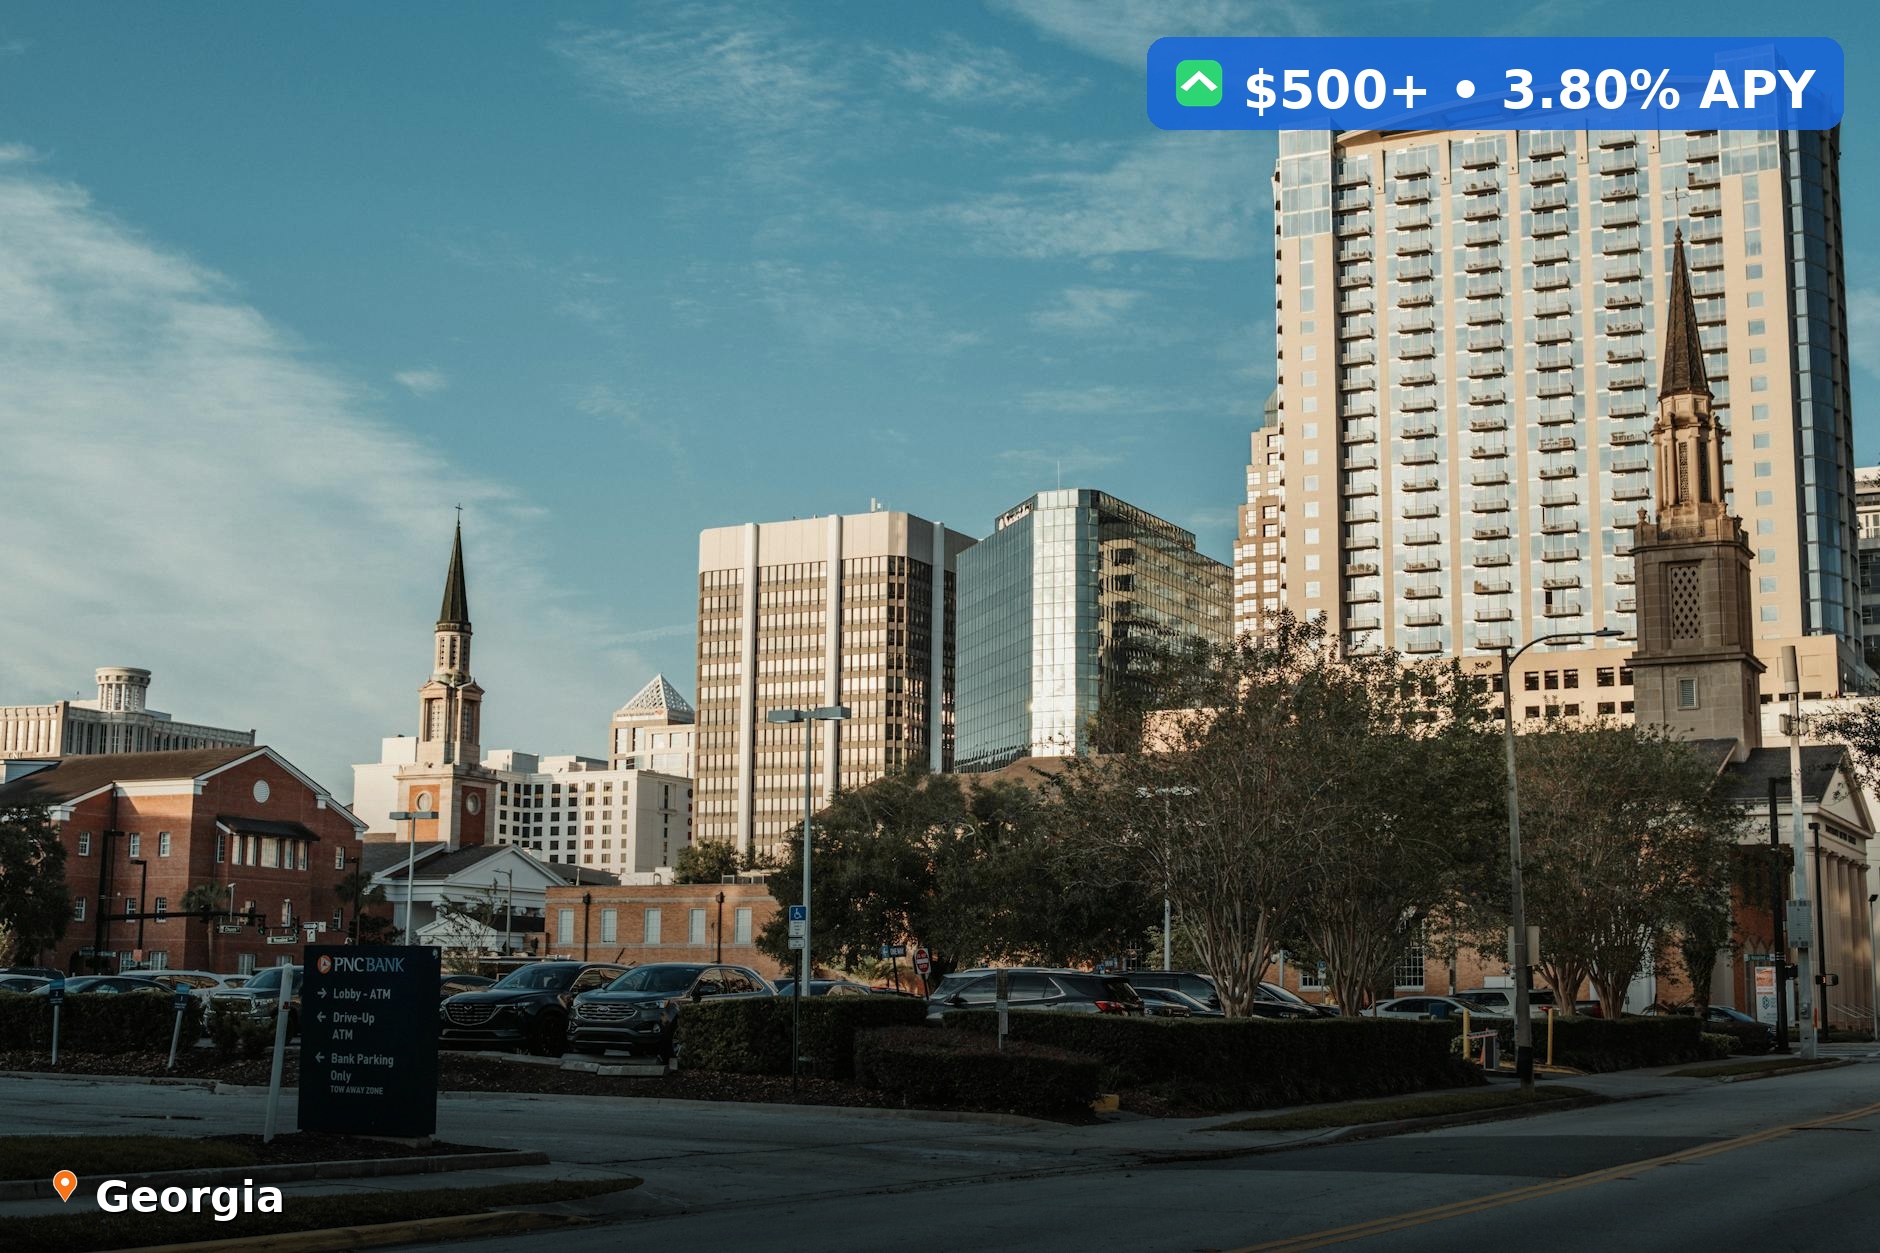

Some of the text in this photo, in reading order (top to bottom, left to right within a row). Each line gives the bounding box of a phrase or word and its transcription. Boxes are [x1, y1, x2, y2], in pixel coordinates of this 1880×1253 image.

[333, 988, 361, 1001] Lobby
[370, 988, 391, 1000] ATM
[333, 1012, 375, 1026] Drive-Up
[332, 1029, 353, 1040] ATM
[331, 1053, 394, 1068] Bank Parking
[331, 1070, 352, 1083] Only
[331, 1085, 383, 1095] TOW AWAY ZONE
